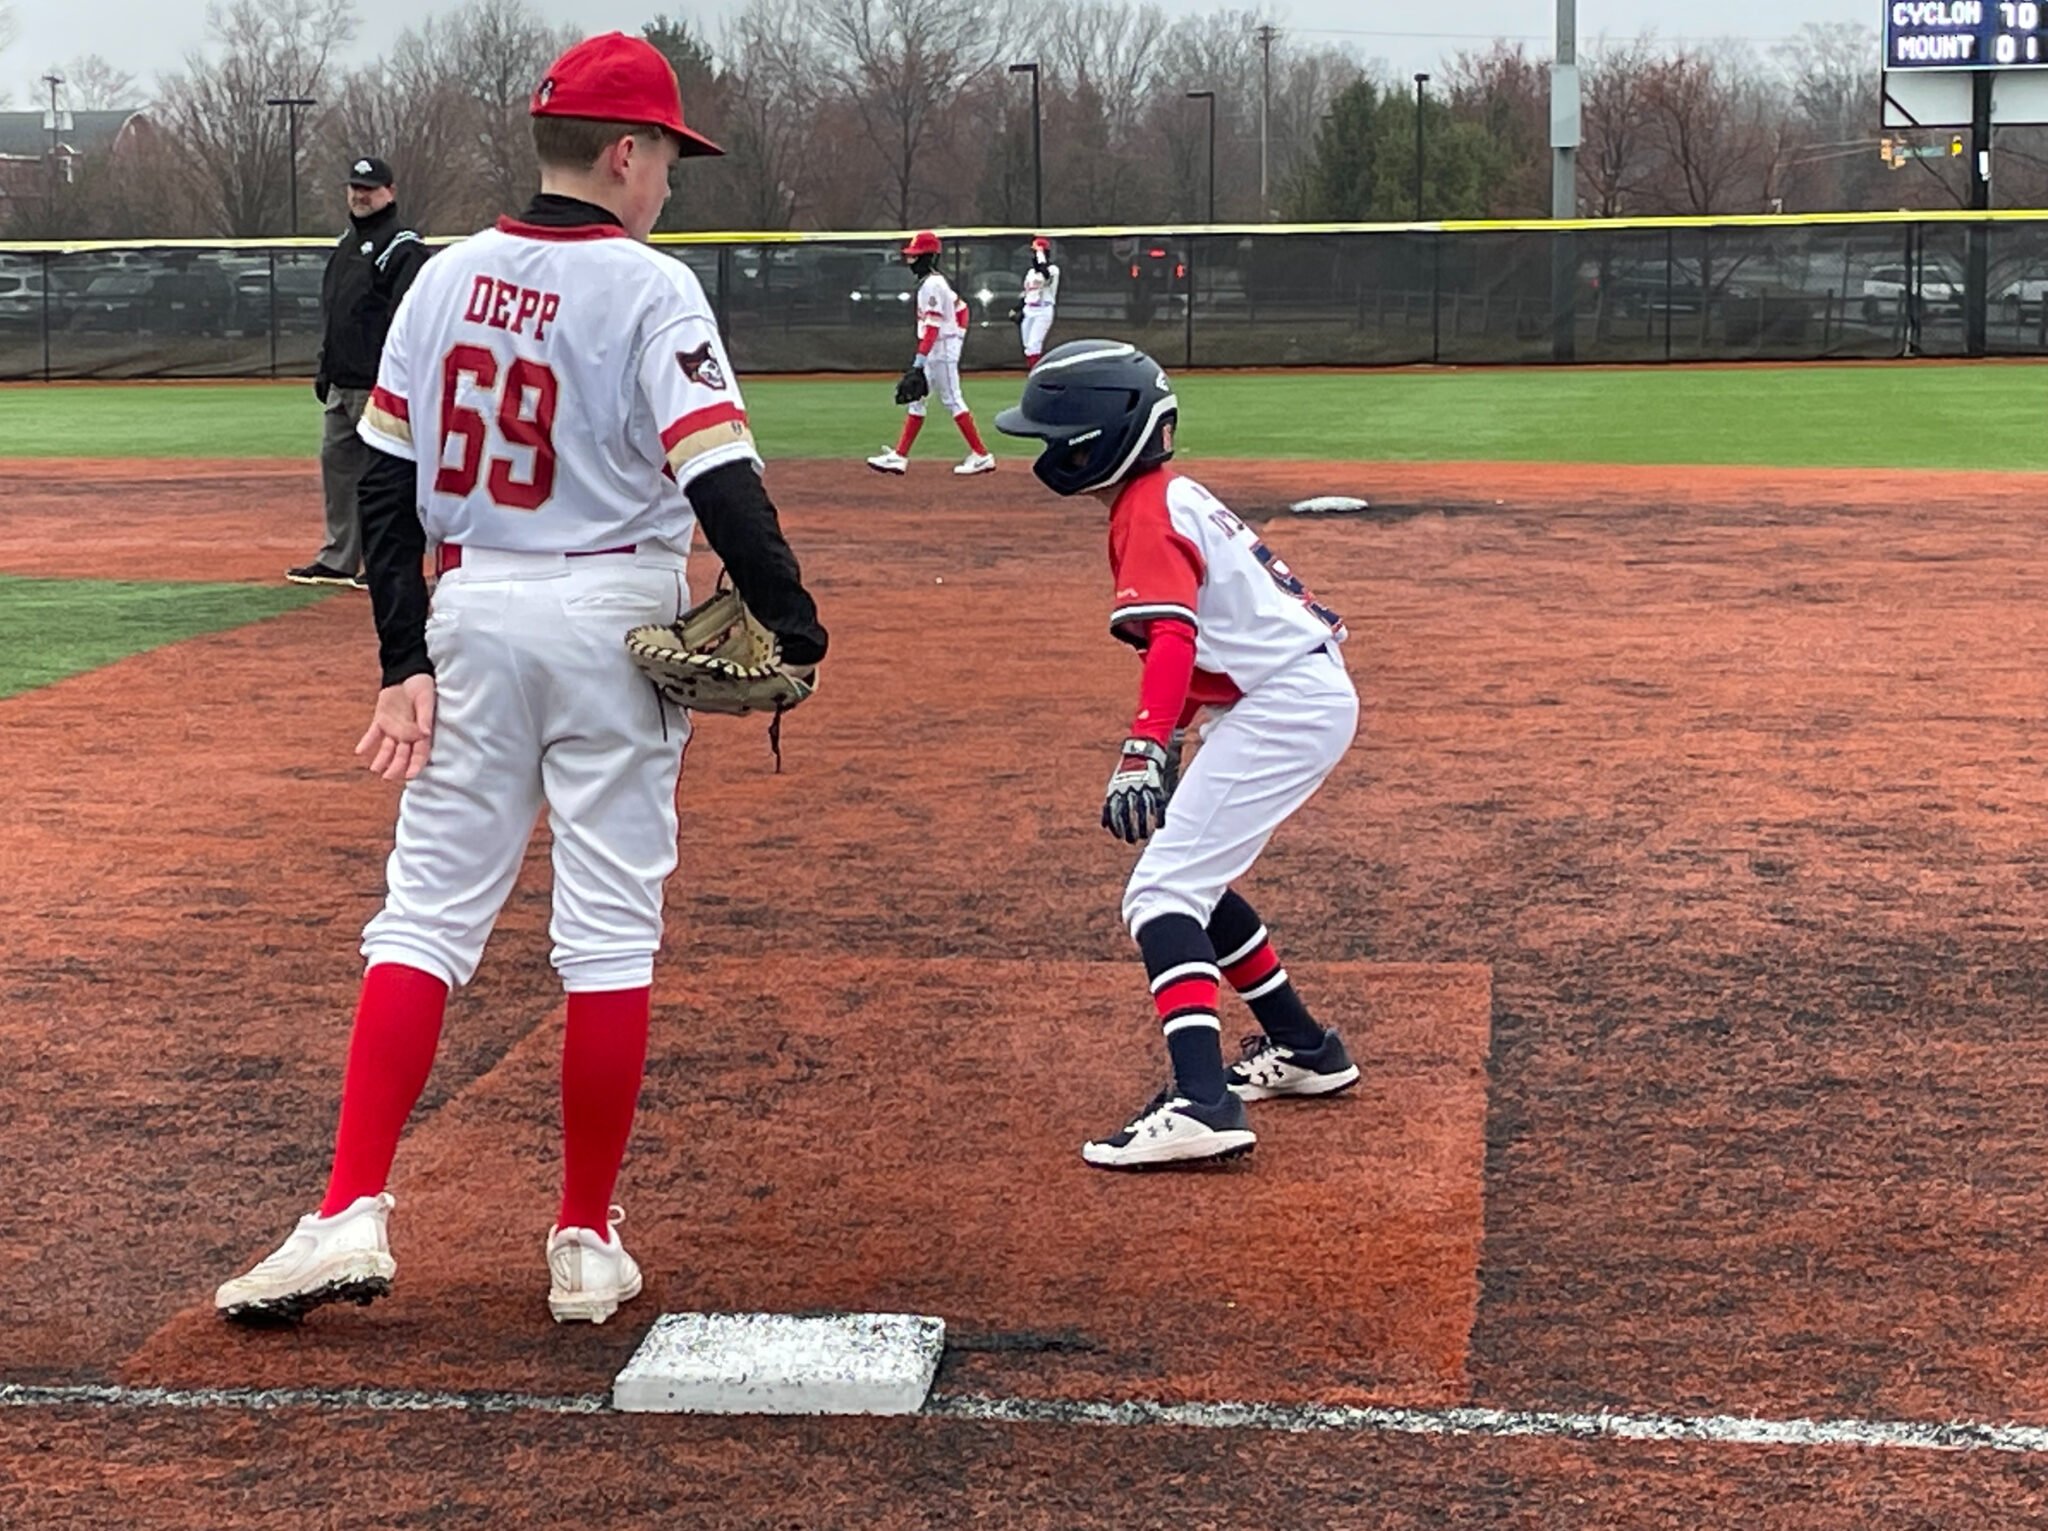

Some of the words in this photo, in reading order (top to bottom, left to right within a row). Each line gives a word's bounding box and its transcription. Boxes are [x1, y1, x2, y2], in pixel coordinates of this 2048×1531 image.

[1897, 34, 1975, 60] MOUNT
[465, 275, 560, 341] DEPP
[434, 343, 558, 510] 69
